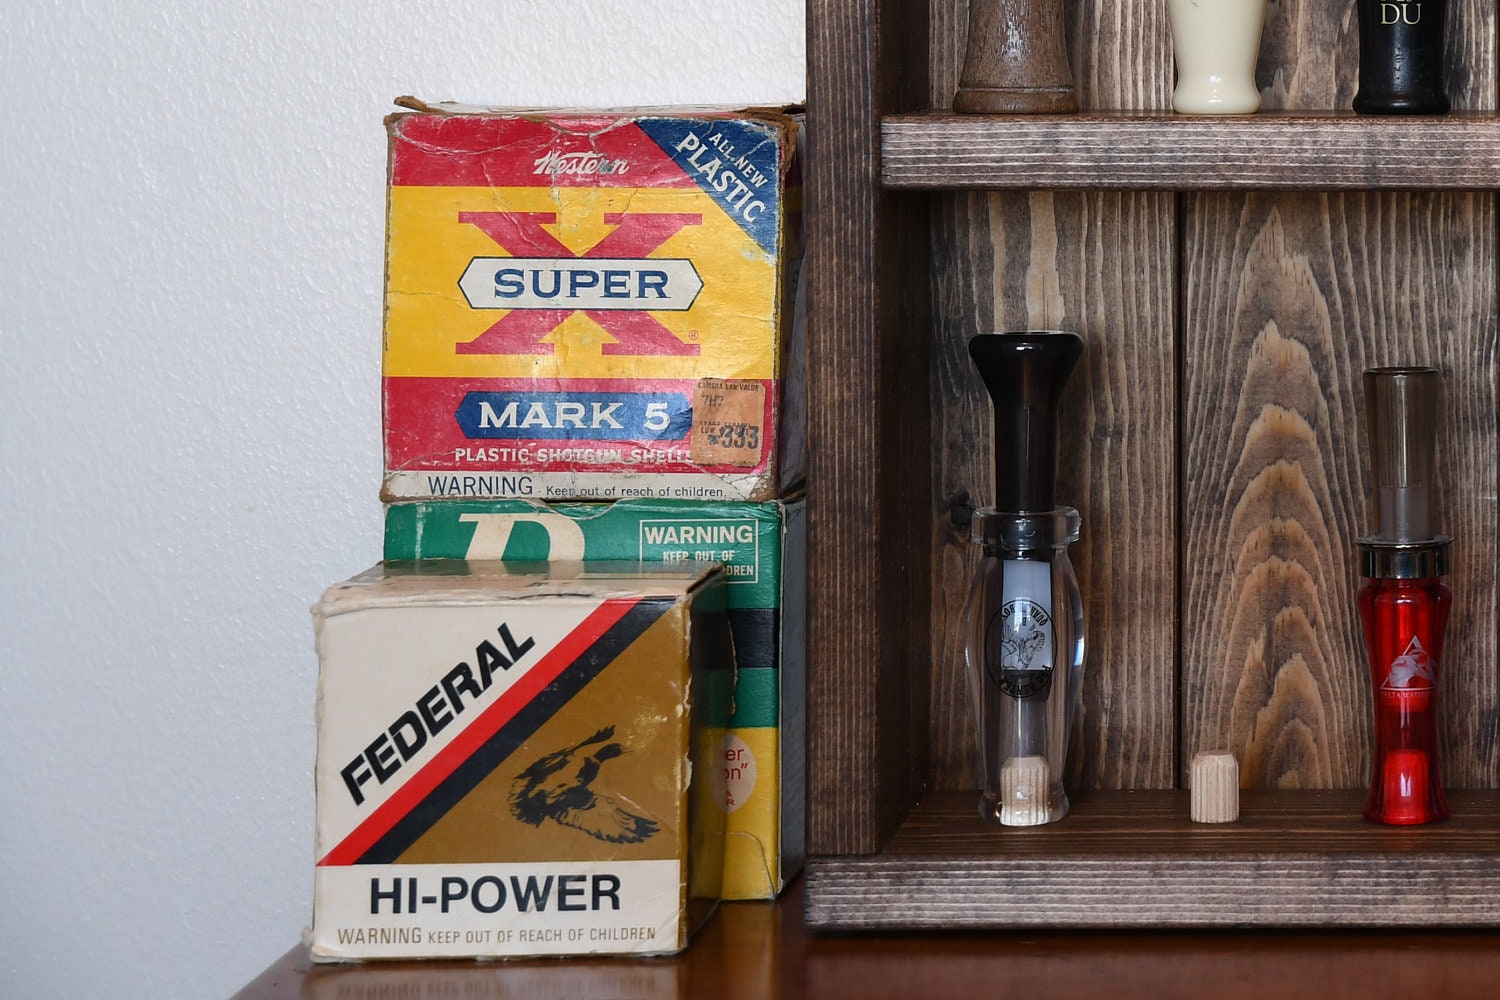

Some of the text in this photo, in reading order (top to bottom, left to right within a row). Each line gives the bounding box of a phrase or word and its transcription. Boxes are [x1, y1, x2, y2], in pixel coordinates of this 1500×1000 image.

[1380, 3, 1422, 25] DU
[533, 151, 630, 176] Western
[674, 131, 766, 223] PLASTIC
[456, 211, 703, 356] X
[494, 268, 671, 300] SUPER
[479, 401, 671, 431] MARK 5
[455, 448, 529, 462] PLASTIC
[537, 448, 623, 463] SHOTGUN
[428, 475, 727, 498] WARNING Keep out of reach of children.
[644, 525, 753, 544] WARNING
[663, 550, 735, 562] KEEP OUT OF
[726, 565, 754, 576] DREN
[340, 621, 536, 807] FEDERAL
[370, 874, 621, 915] HI-POWER
[338, 926, 656, 945] WARNING KEEP OUT OF REACH OF CHILDREN
